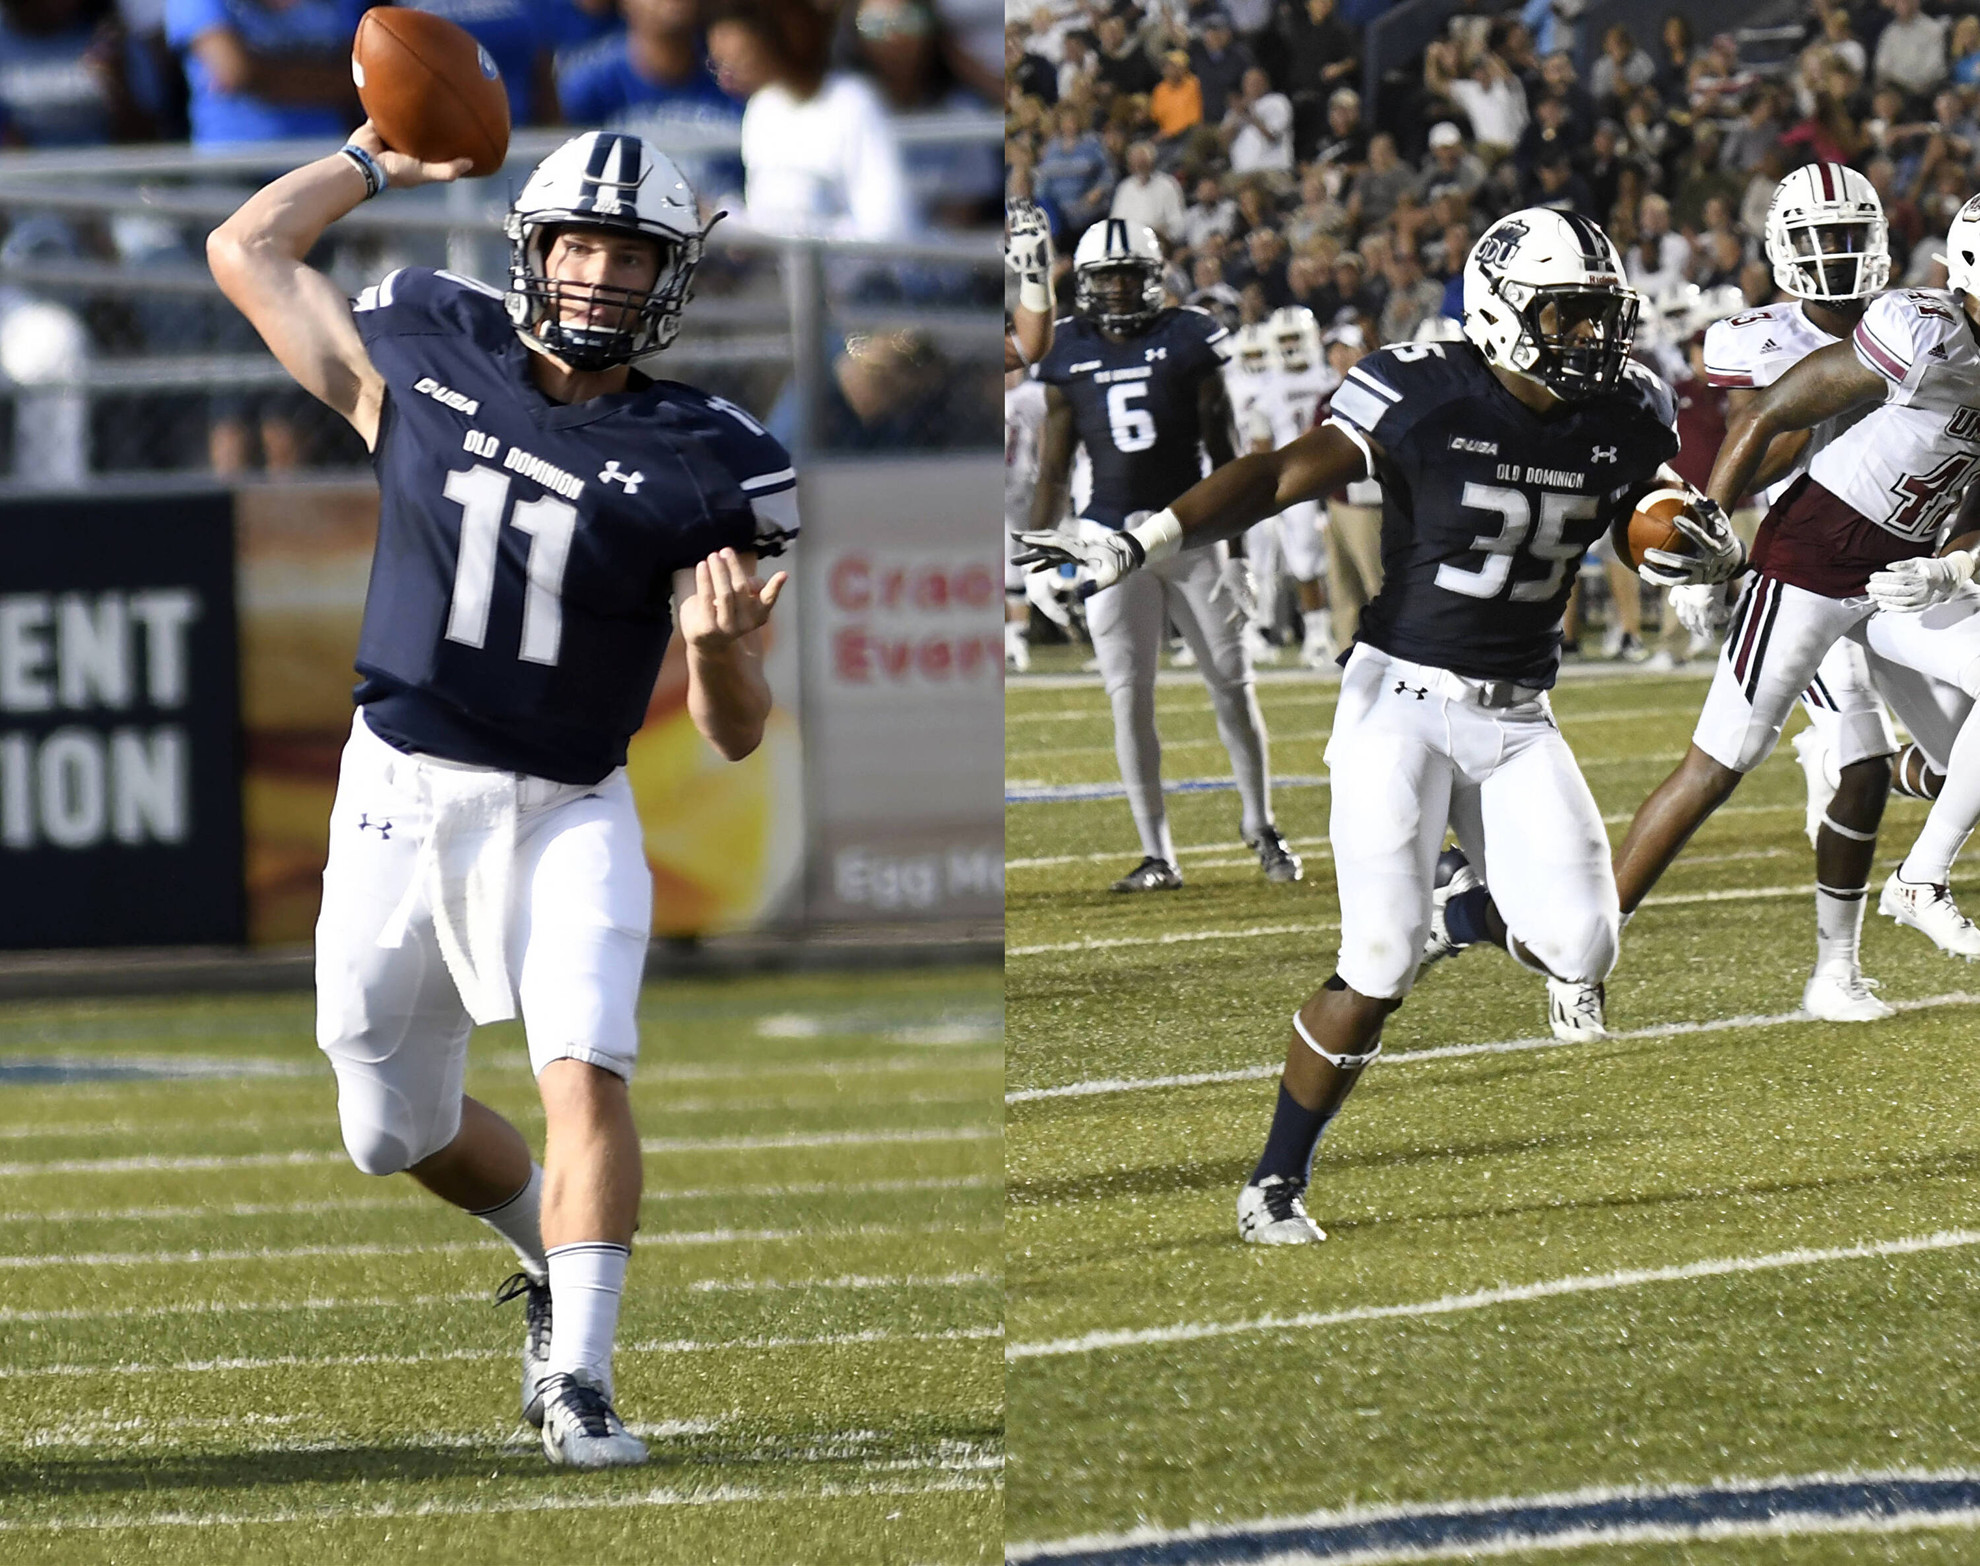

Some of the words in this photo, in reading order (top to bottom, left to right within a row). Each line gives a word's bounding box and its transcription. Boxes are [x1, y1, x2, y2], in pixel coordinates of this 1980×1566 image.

[1475, 236, 1521, 270] ODU
[1107, 382, 1156, 453] 6
[462, 429, 500, 459] OLD
[503, 446, 585, 500] DOMINION
[1496, 463, 1521, 482] OLD
[1525, 467, 1585, 489] DOMINION
[442, 463, 579, 667] 11
[1433, 481, 1600, 602] 35
[829, 551, 1004, 613] Crac
[0, 588, 197, 711] ENT
[0, 727, 187, 848] ION
